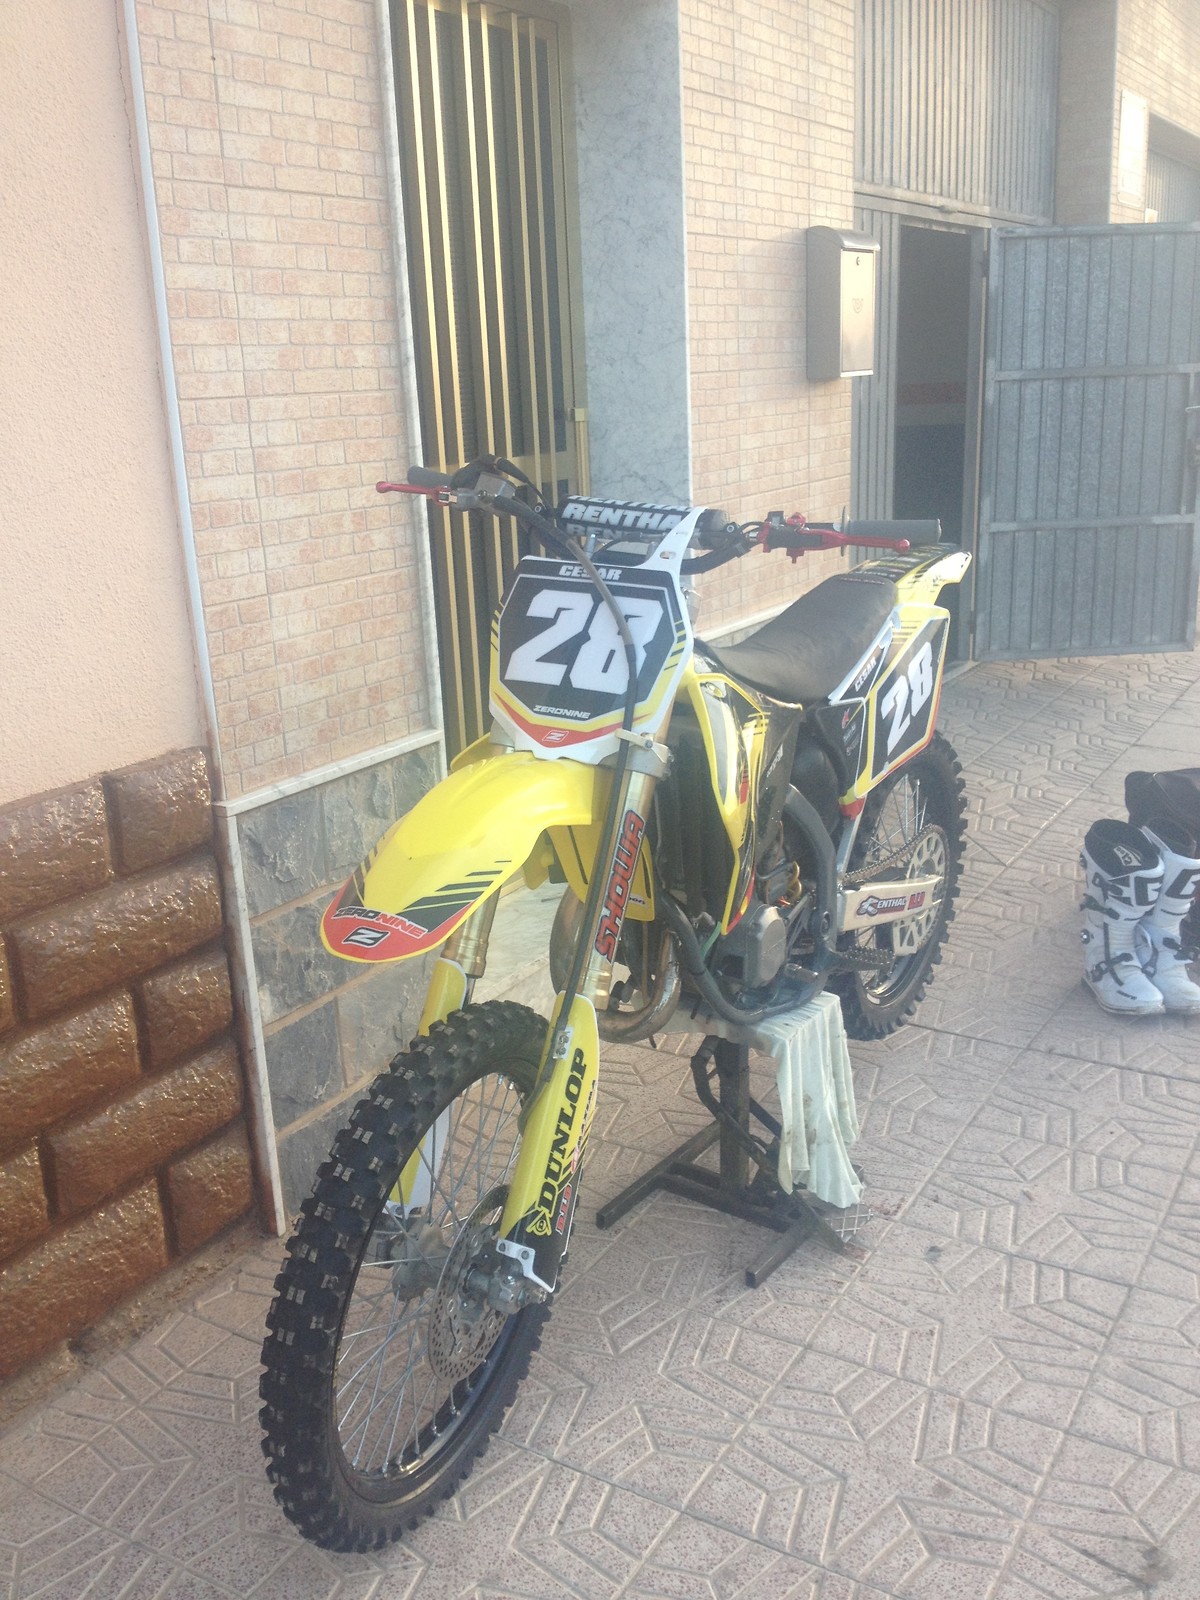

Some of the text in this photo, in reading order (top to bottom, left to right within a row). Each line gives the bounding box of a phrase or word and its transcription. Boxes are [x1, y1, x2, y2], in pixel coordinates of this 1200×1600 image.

[561, 502, 683, 531] RENTHA
[559, 565, 622, 580] CESAR
[504, 589, 664, 695] 28
[533, 704, 591, 720] ZERONINE
[881, 641, 933, 756] 28
[596, 809, 646, 964] SHOWA
[331, 905, 429, 939] ZERONINE
[538, 1047, 588, 1216] DUNLOP
